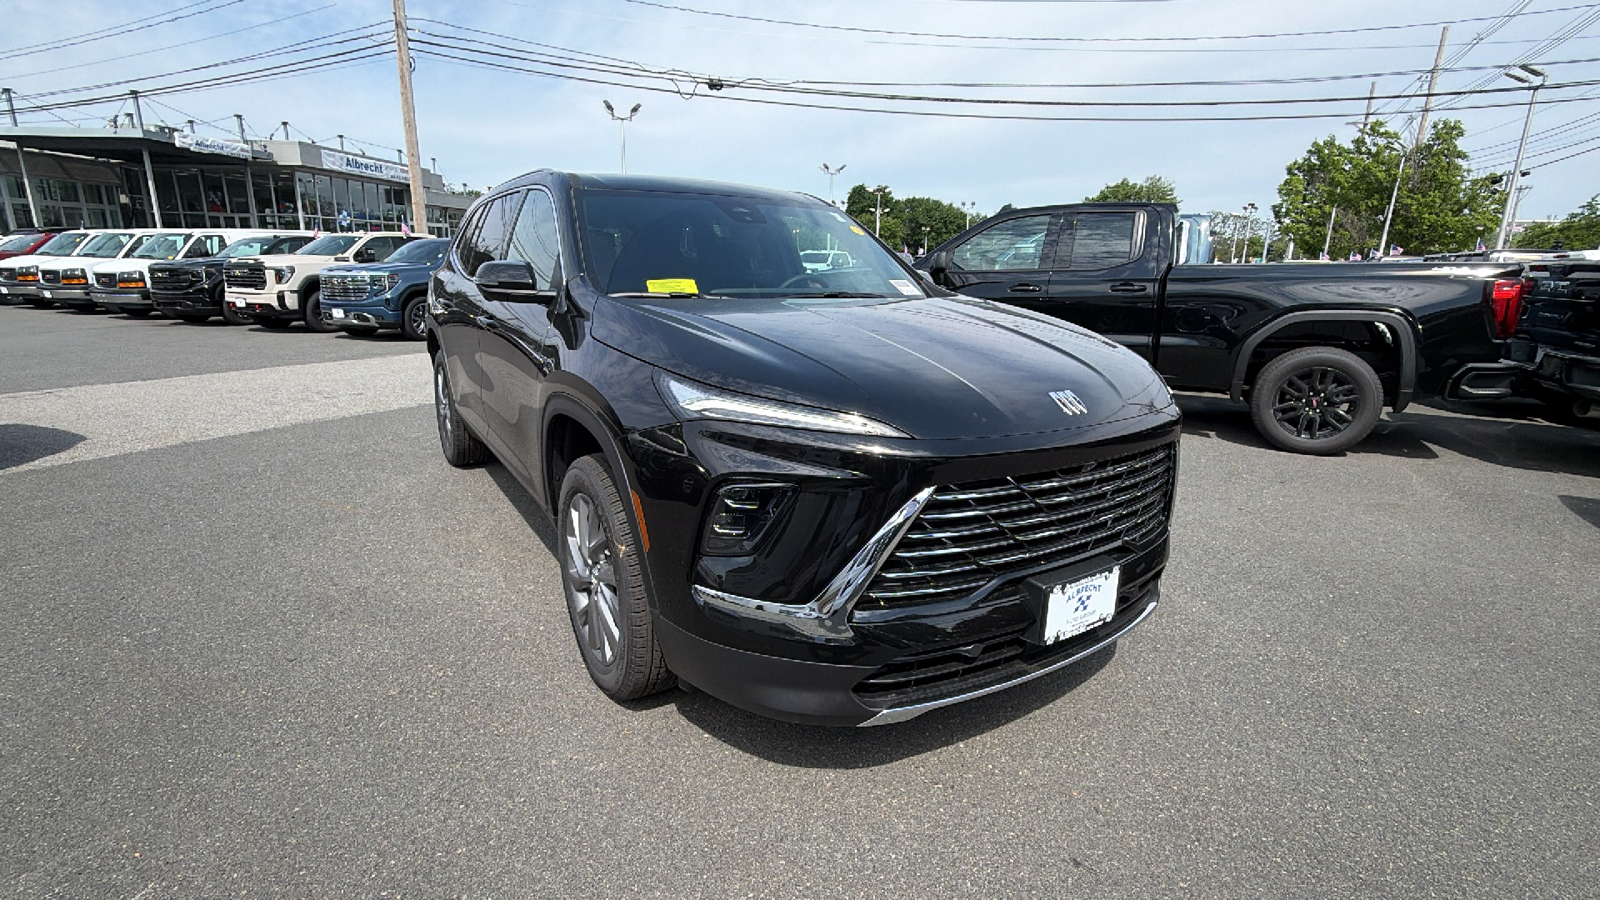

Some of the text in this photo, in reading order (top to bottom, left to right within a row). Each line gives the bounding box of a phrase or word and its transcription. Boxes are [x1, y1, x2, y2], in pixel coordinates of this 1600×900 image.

[345, 156, 384, 174] Albrecht
[1066, 584, 1102, 603] ALBRECHT
[1079, 609, 1097, 619] GROUP
